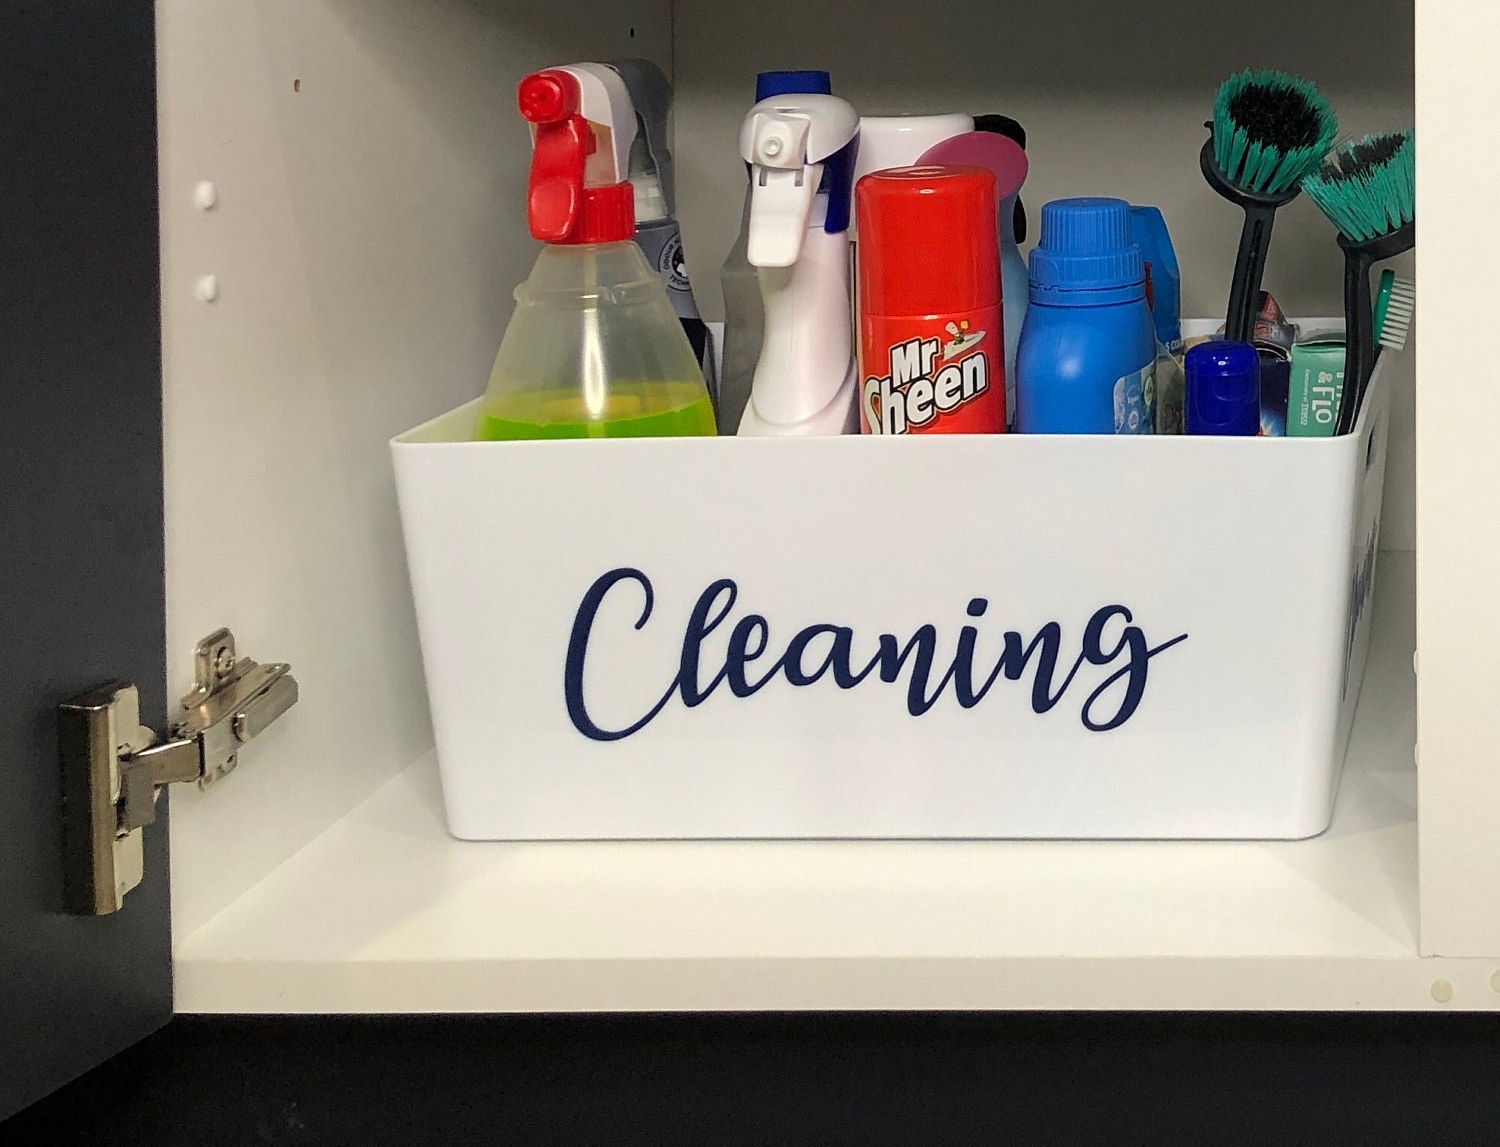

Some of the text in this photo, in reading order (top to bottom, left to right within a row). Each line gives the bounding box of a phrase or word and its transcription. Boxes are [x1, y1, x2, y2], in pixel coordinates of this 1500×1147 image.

[863, 352, 988, 435] Sheen
[890, 337, 939, 390] Mr
[1311, 371, 1335, 424] & FLO
[564, 567, 1189, 742] Cleaning
